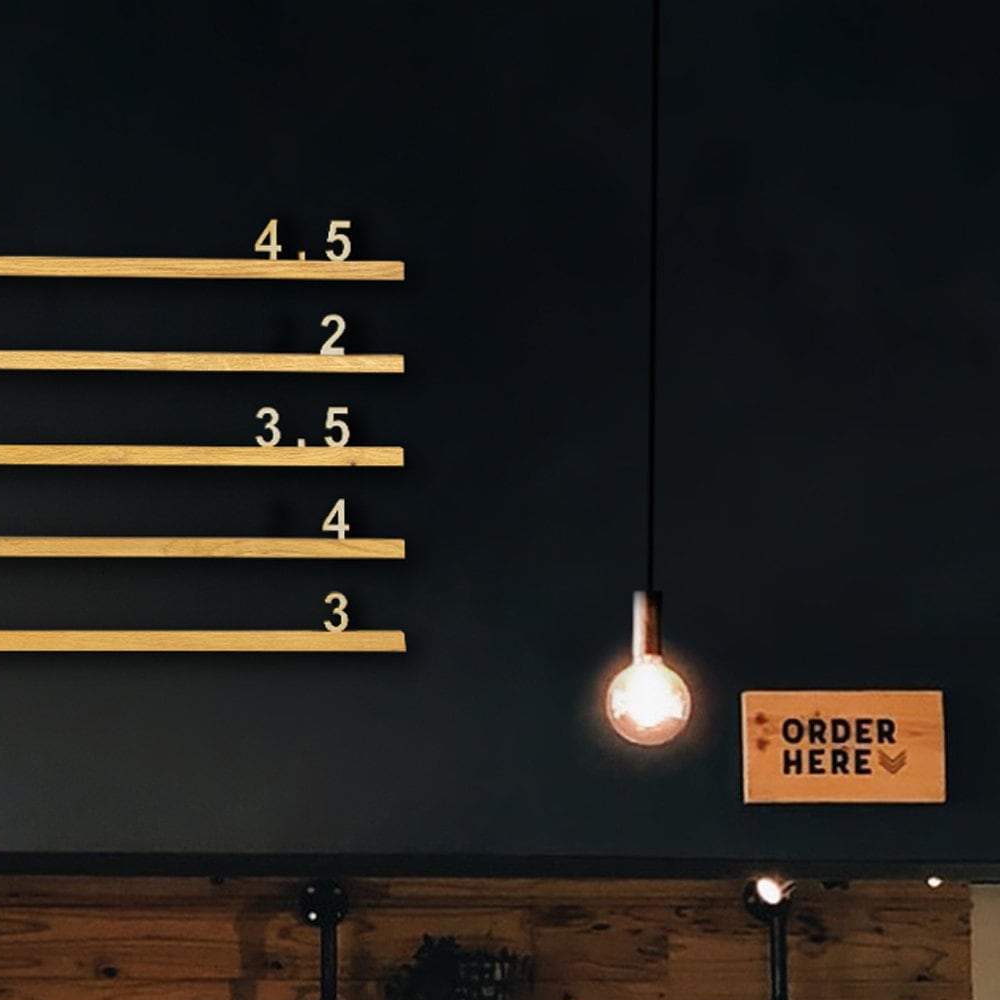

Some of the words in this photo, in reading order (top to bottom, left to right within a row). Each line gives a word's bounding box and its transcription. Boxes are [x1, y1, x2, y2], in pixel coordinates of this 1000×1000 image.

[255, 219, 351, 261] 4.5
[320, 314, 346, 355] 2
[255, 407, 350, 447] 3.5
[322, 499, 350, 539] 4
[324, 592, 349, 632] 3
[782, 718, 896, 744] ORDER
[783, 749, 872, 775] HERE
